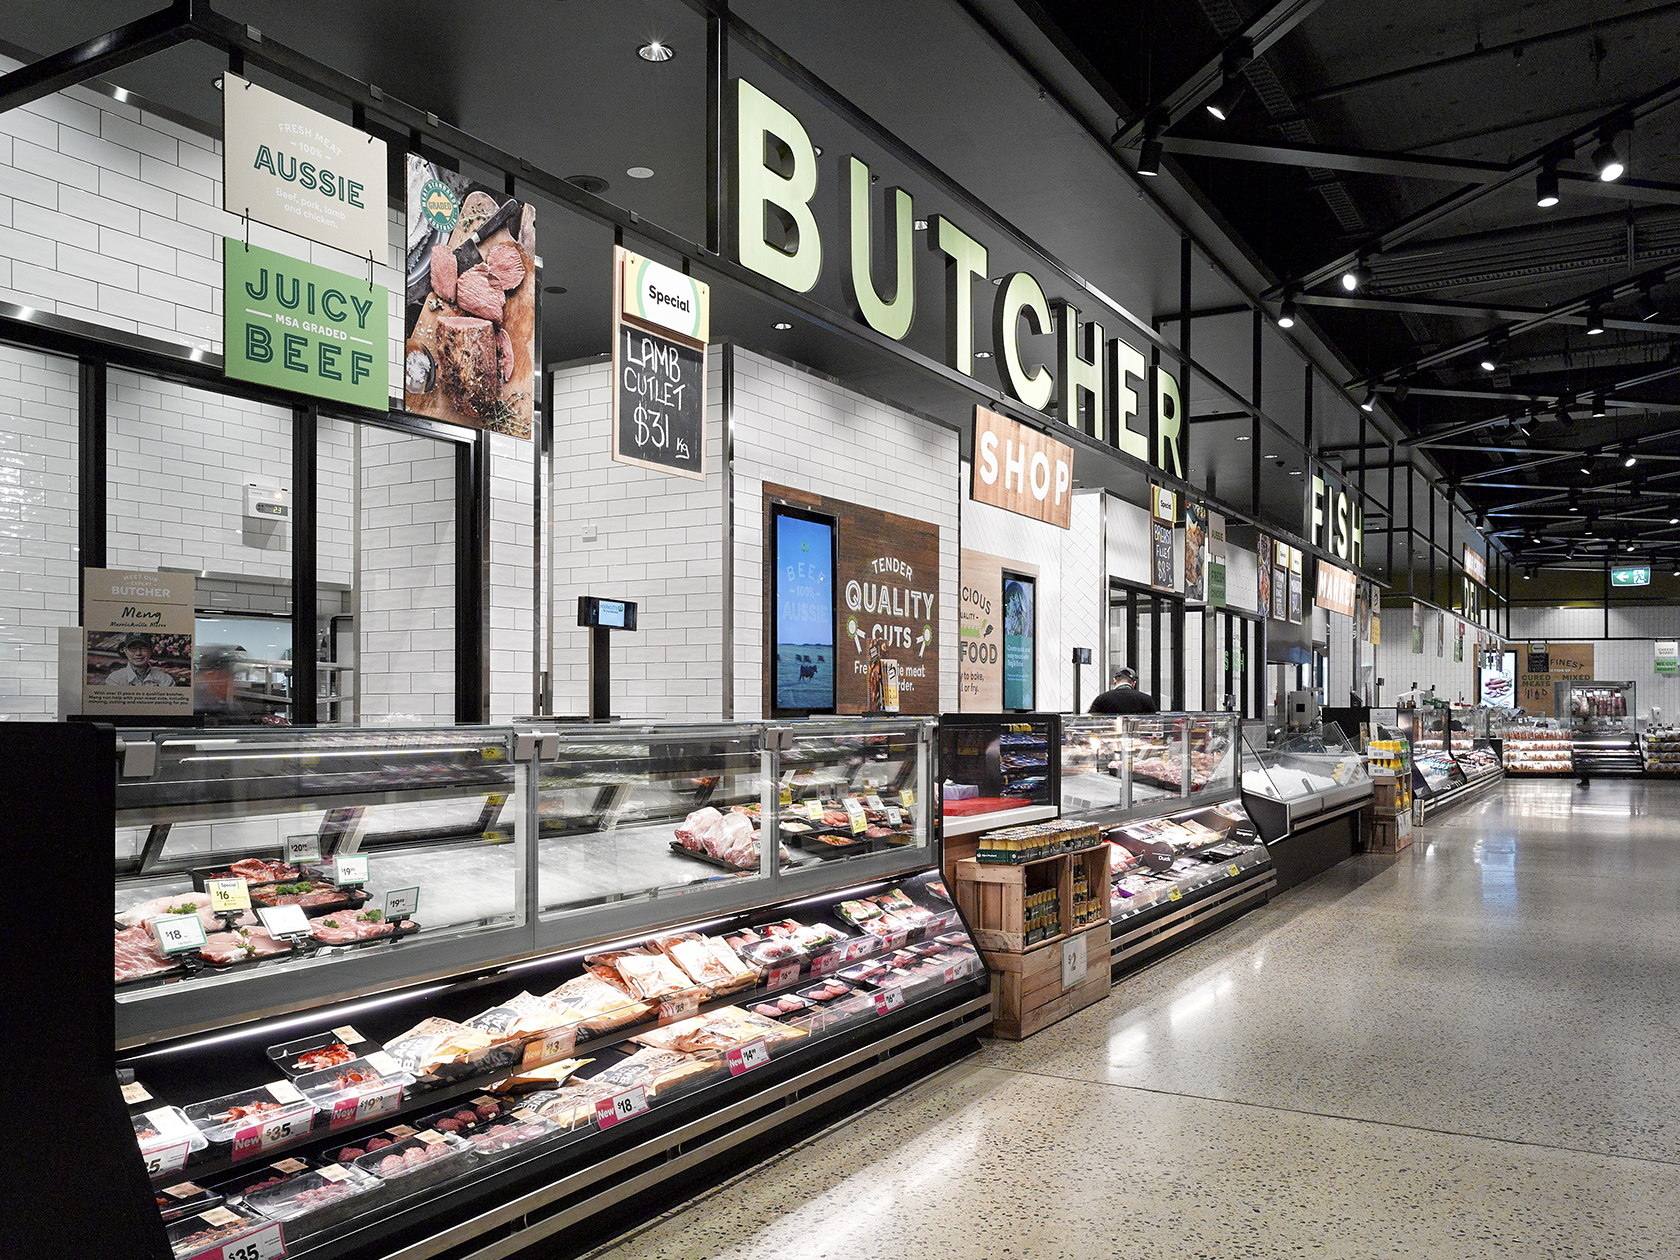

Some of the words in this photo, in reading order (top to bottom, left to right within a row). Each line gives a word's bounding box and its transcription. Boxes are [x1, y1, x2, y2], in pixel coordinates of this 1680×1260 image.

[278, 123, 312, 138] FRESH
[315, 132, 343, 156] MEAT
[299, 142, 323, 159] 100%
[253, 144, 364, 209] AUSSIE
[275, 186, 298, 204] Beef,
[301, 197, 322, 214] pork,
[324, 204, 346, 220] lamb
[284, 203, 302, 216] and
[303, 208, 339, 229] chicken.
[737, 77, 1184, 481] BUTCHER
[245, 268, 373, 329] JUICY
[648, 285, 690, 313] Special
[275, 313, 299, 329] MSA
[302, 320, 348, 341] GRADED
[245, 322, 373, 385] BEEF
[626, 330, 681, 383] LAMB
[623, 366, 686, 411] CUTLET
[979, 430, 1070, 506] SHOP
[1311, 474, 1362, 568] FISH
[786, 562, 826, 584] BEEF
[871, 556, 913, 582] TENDER
[111, 585, 171, 598] BUTCHER
[845, 579, 935, 621] QUALITY
[1318, 570, 1356, 608] MARKET
[121, 606, 162, 625] Meng
[782, 601, 829, 624] AUSSIE
[871, 623, 912, 649] CUTS
[960, 640, 998, 664] FOOD
[1549, 658, 1585, 670] FINEST
[905, 664, 926, 678] meat
[963, 672, 970, 681] to
[215, 890, 230, 901] $16
[220, 881, 237, 889] Special
[165, 929, 182, 941] $18
[524, 1049, 542, 1061] New
[729, 1057, 743, 1069] New
[333, 1106, 356, 1120] New
[597, 1107, 615, 1121] New
[617, 1098, 633, 1114] $18
[234, 1135, 261, 1151] New
[266, 1121, 291, 1142] $35
[228, 1242, 260, 1260] $35
